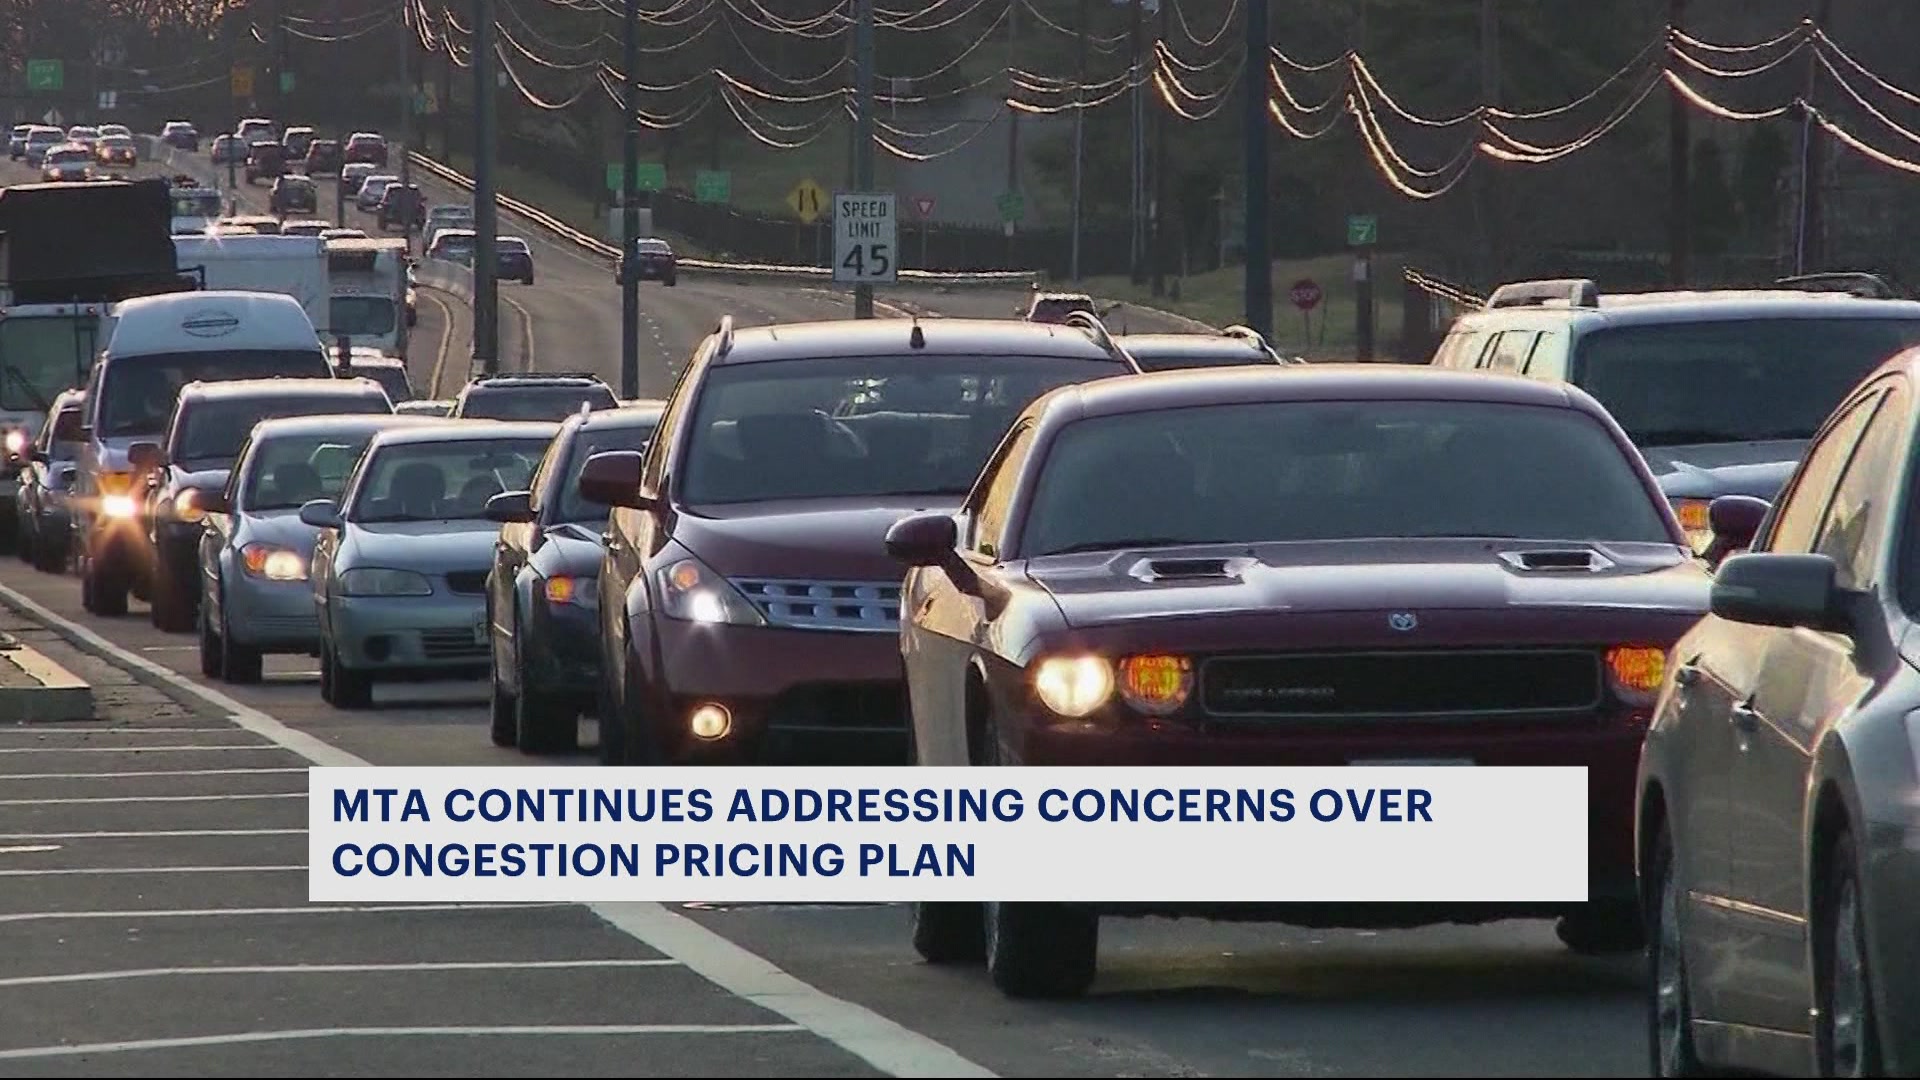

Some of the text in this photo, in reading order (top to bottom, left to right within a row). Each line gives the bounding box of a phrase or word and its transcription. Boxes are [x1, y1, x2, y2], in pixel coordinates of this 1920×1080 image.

[842, 201, 887, 218] SPEED
[849, 222, 880, 238] LIMIT
[842, 244, 889, 276] 45
